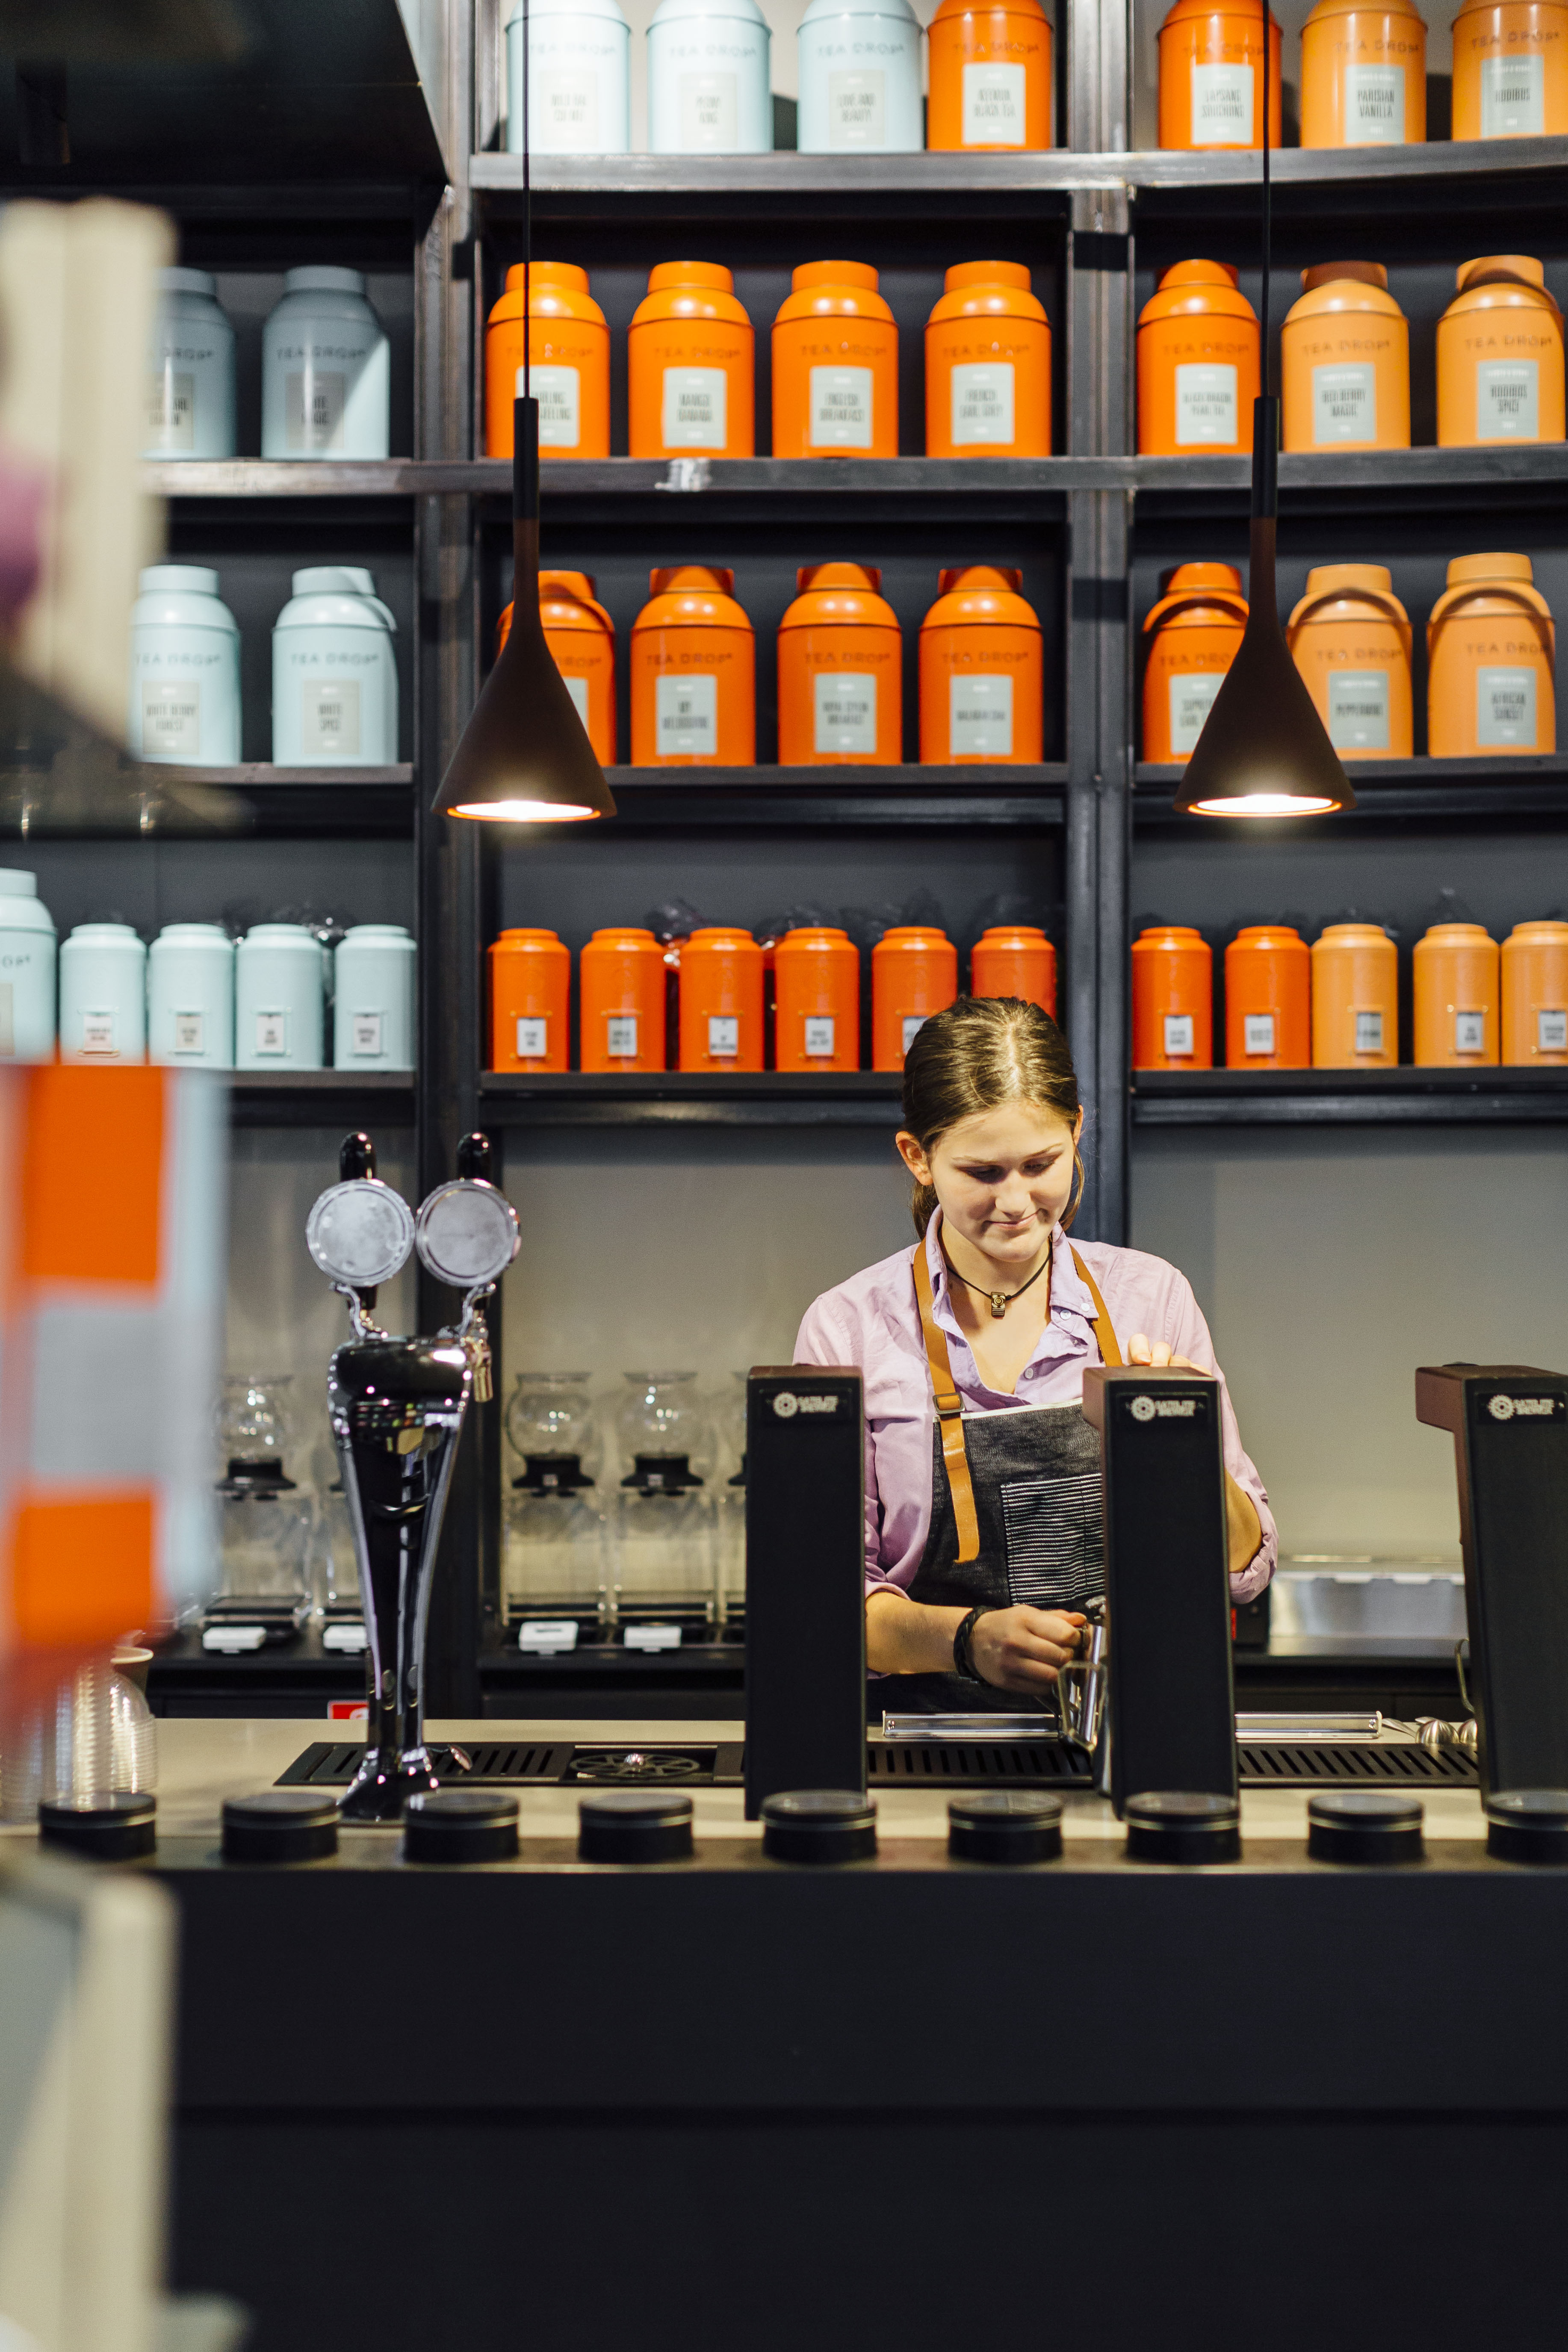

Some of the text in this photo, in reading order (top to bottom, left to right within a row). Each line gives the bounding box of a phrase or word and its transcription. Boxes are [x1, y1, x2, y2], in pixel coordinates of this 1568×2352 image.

[1357, 89, 1394, 104] PARISIAN
[1358, 104, 1394, 119] VANILLA
[1195, 652, 1232, 665] DRO
